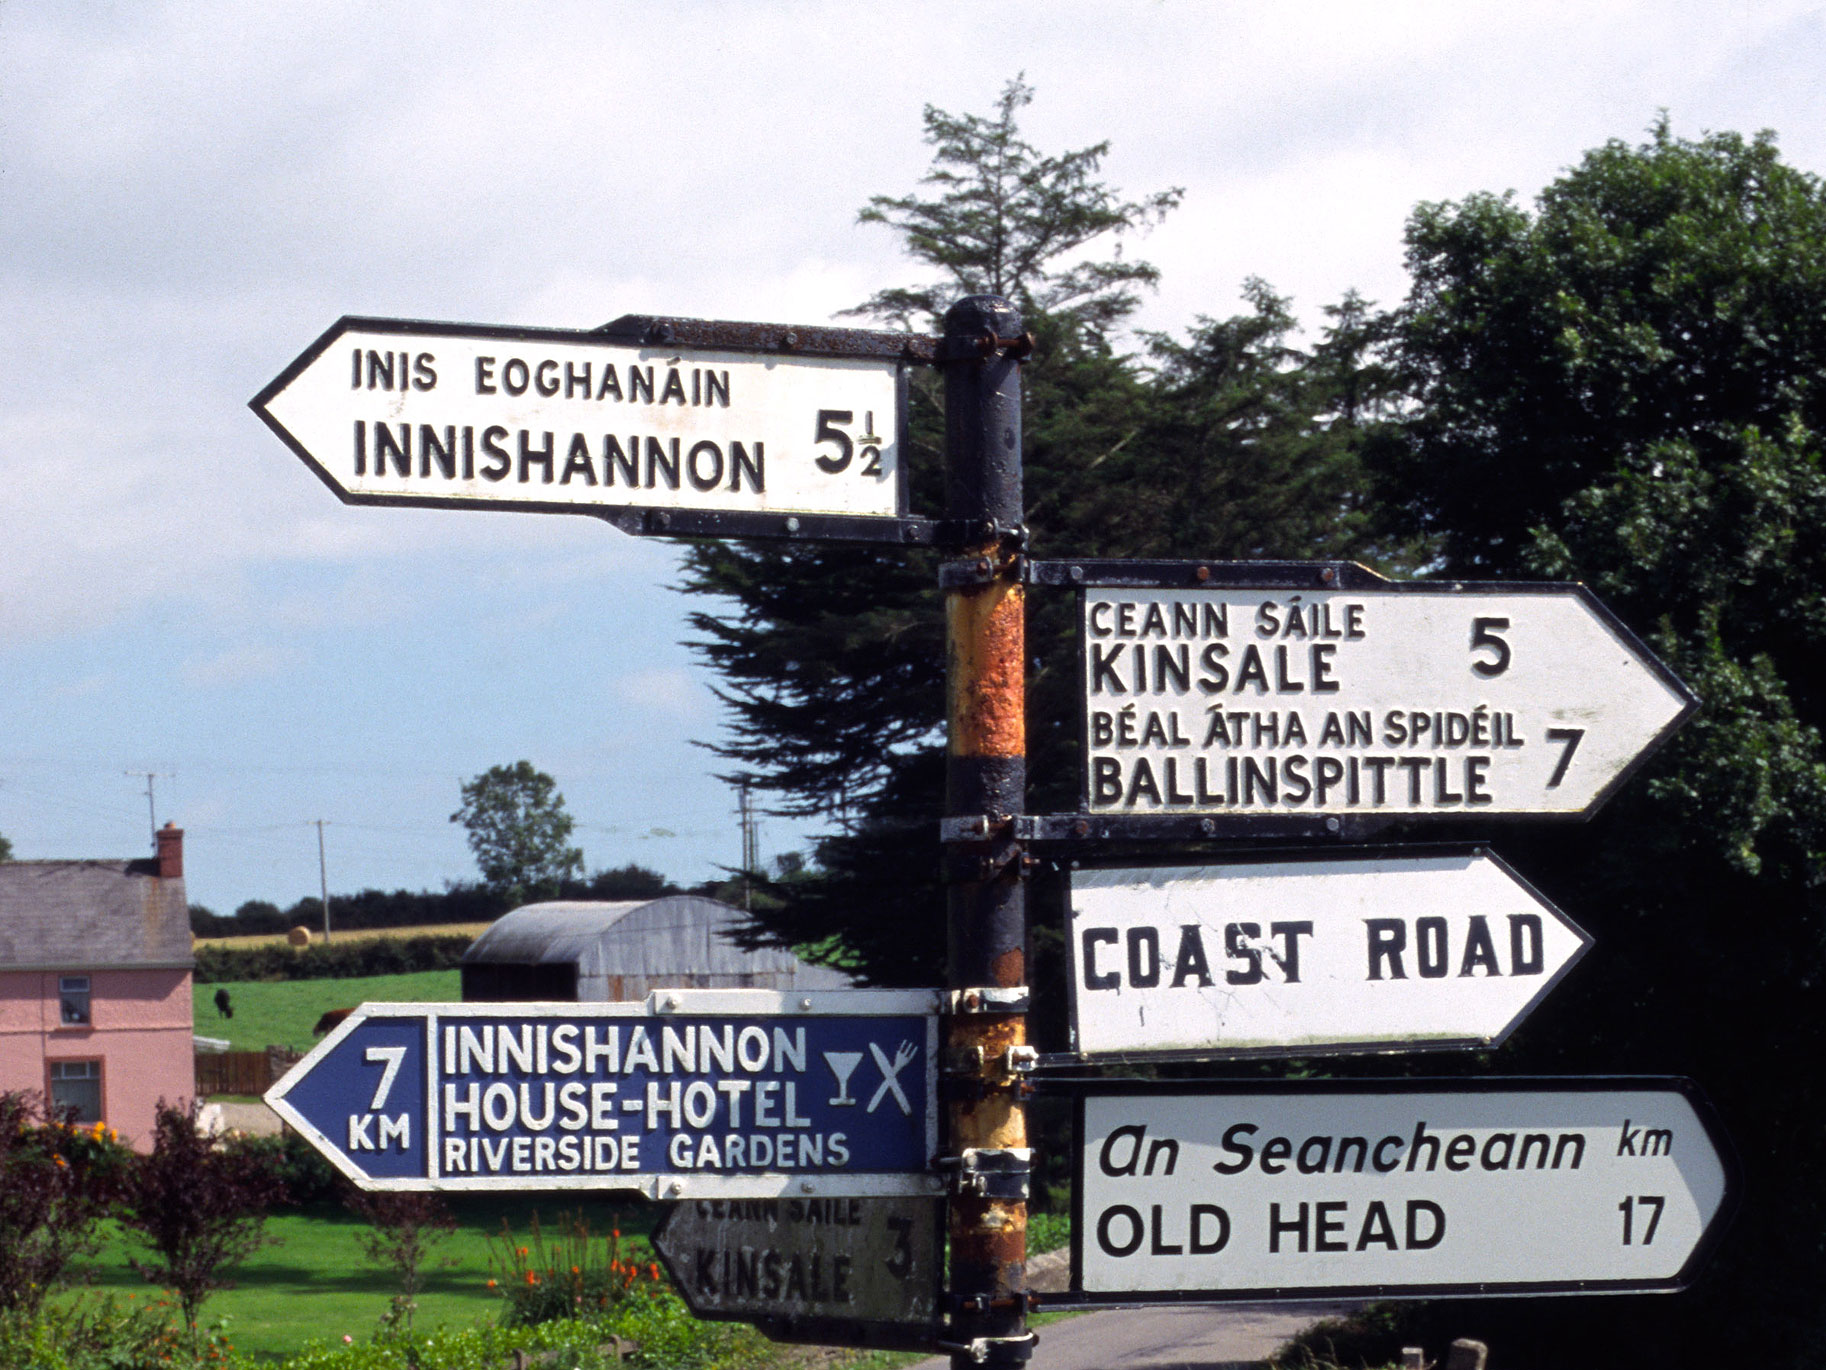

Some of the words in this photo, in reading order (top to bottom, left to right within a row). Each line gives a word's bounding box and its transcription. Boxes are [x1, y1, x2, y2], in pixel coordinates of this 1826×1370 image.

[351, 349, 437, 392] INIS
[476, 356, 731, 408] EOGHANÁIN
[353, 420, 765, 493] INNISHANNON
[1090, 601, 1228, 638] CEANN
[1257, 596, 1366, 638] SÁILE
[1092, 643, 1340, 694] KINSALE
[1472, 617, 1511, 676] 5
[1092, 703, 1191, 748] BÉAL
[1202, 703, 1308, 749] ÁTHA
[1317, 711, 1374, 746] AN
[1384, 705, 1525, 748] SPIDÉIL
[1091, 755, 1494, 807] BALLINSPITTLE
[1547, 728, 1586, 787] 7
[1082, 921, 1313, 990] COAST
[1365, 914, 1544, 980] ROAD
[445, 1024, 806, 1075] INNISHANNON
[366, 1046, 407, 1110] 7
[349, 1113, 410, 1150] KM
[445, 1080, 811, 1132] HOUSE-HOTEL
[445, 1136, 640, 1172] RIVERSIDE
[670, 1132, 851, 1169] GARDENS
[1213, 1122, 1585, 1176] Seancheann
[1617, 1120, 1673, 1157] km
[886, 1216, 913, 1280] 3
[1097, 1205, 1231, 1258] OLD
[1269, 1200, 1446, 1254] HEAD
[1618, 1196, 1665, 1246] 17
[696, 1248, 851, 1302] KINSALE
